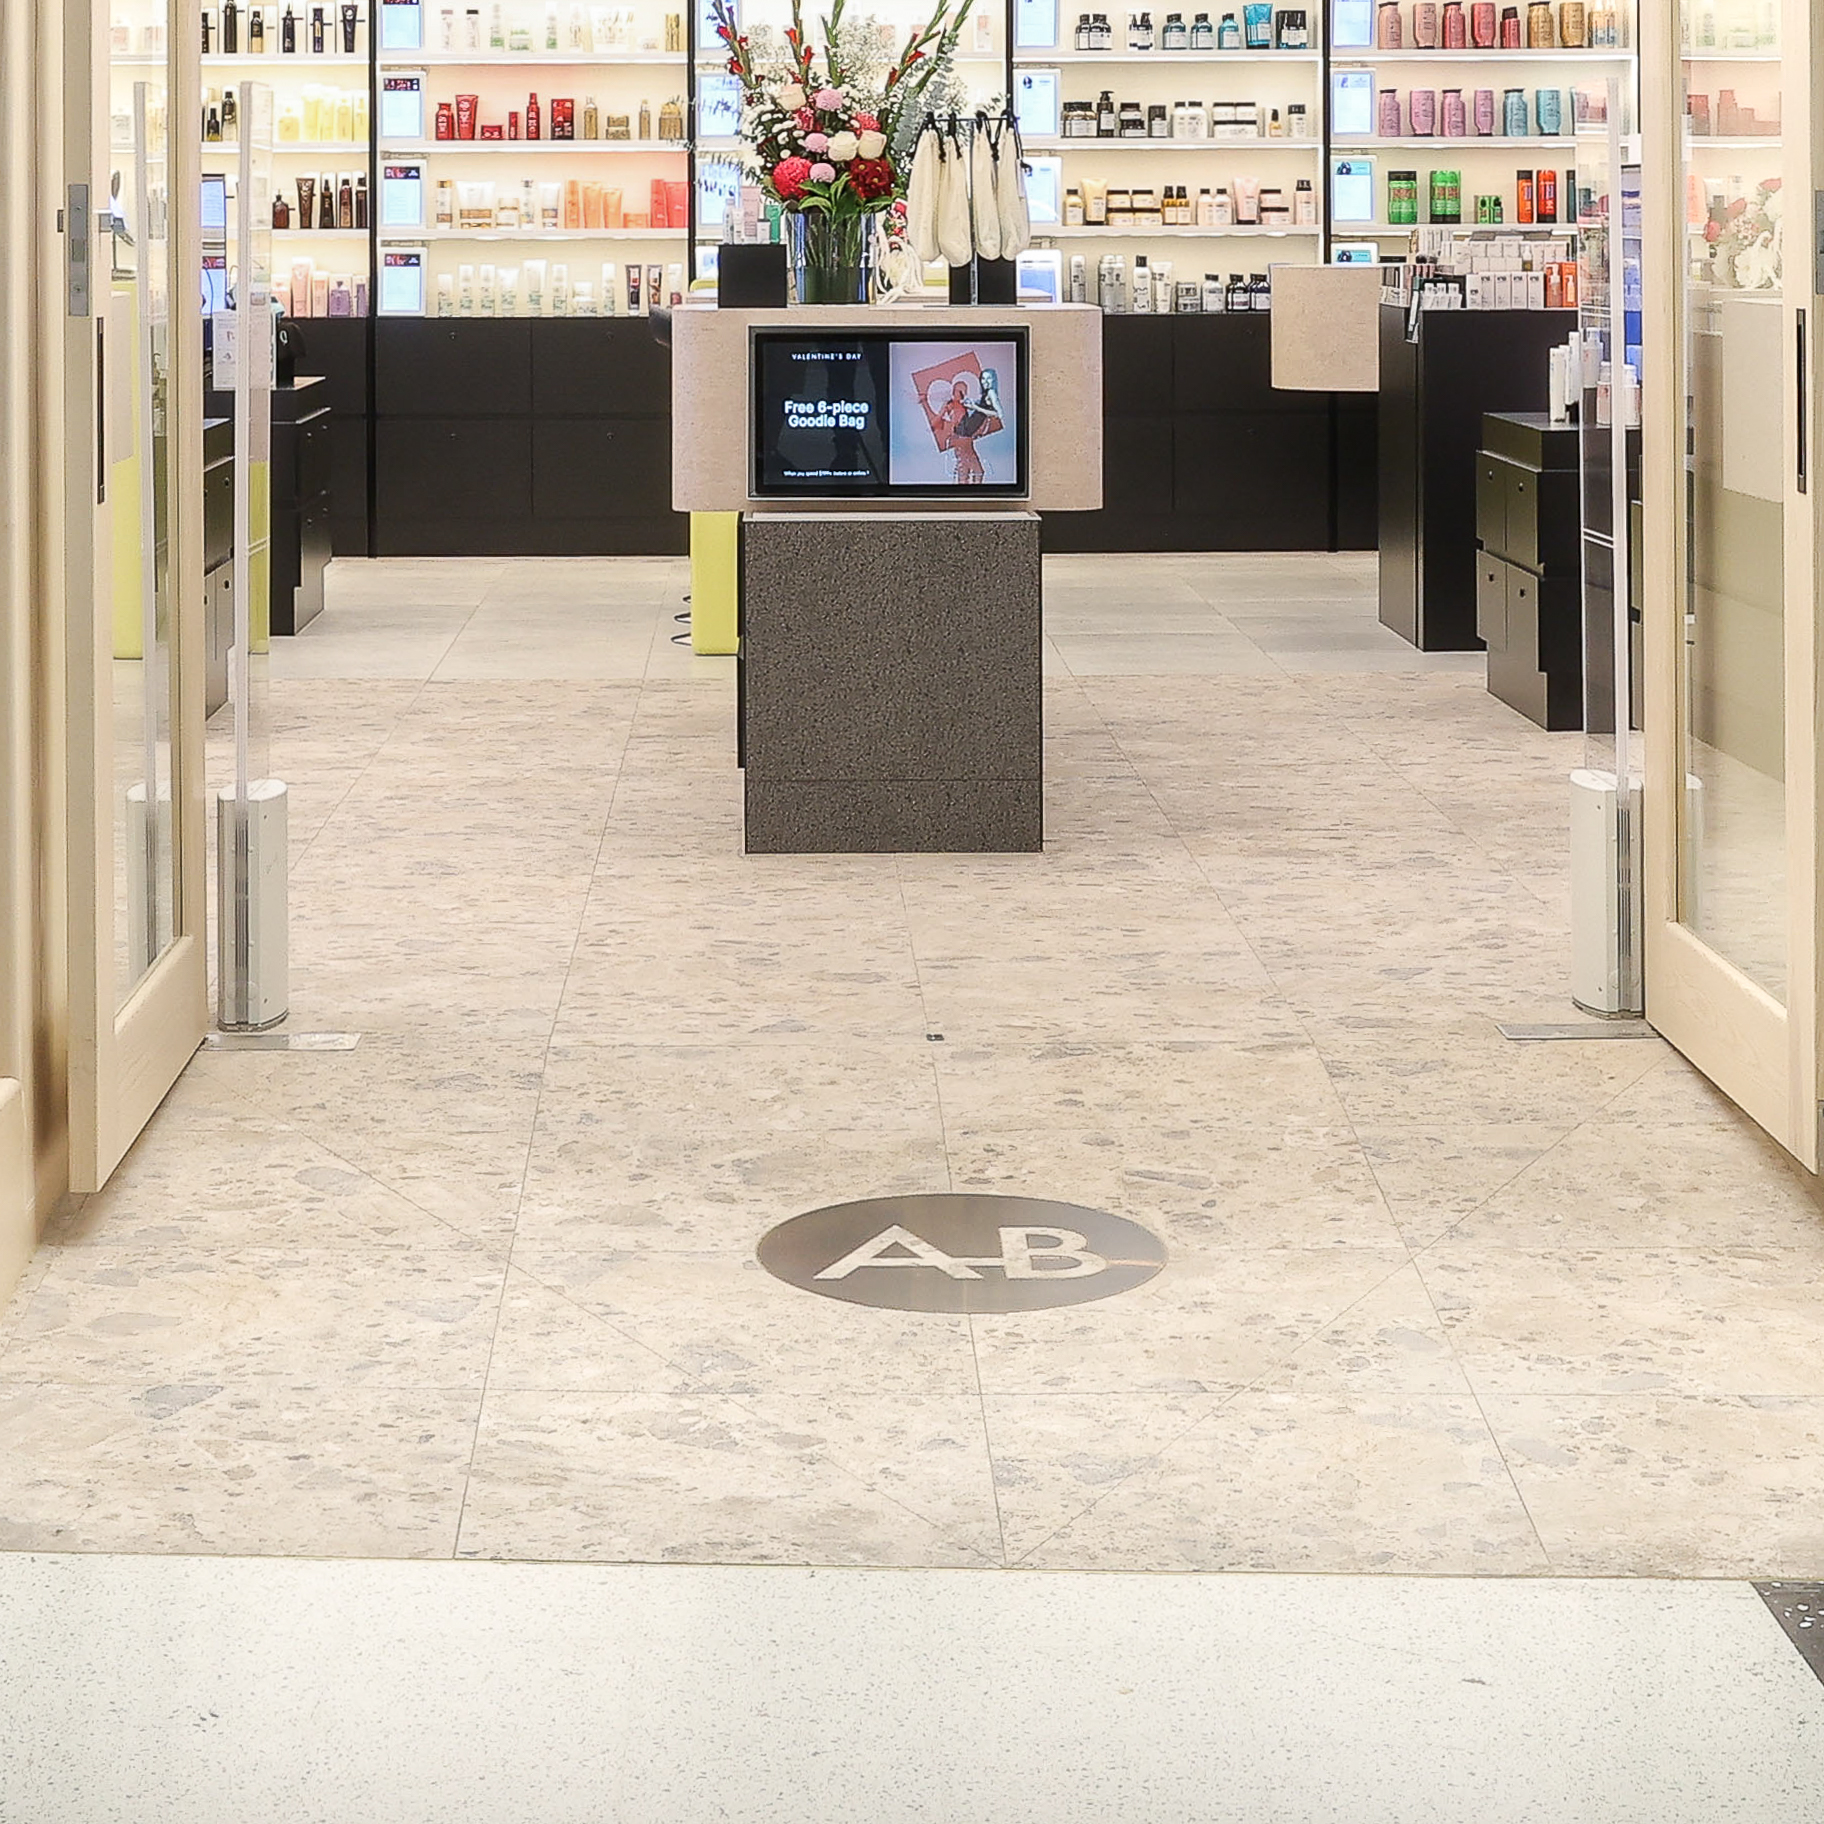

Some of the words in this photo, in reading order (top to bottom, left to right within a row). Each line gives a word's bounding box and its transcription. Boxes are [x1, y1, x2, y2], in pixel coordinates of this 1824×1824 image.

[791, 353, 843, 361] VALENTINE'S
[845, 353, 862, 361] DAY
[784, 400, 814, 414] Free
[817, 400, 869, 416] 6-piece
[788, 414, 836, 428] Goodie
[838, 414, 865, 430] Bag
